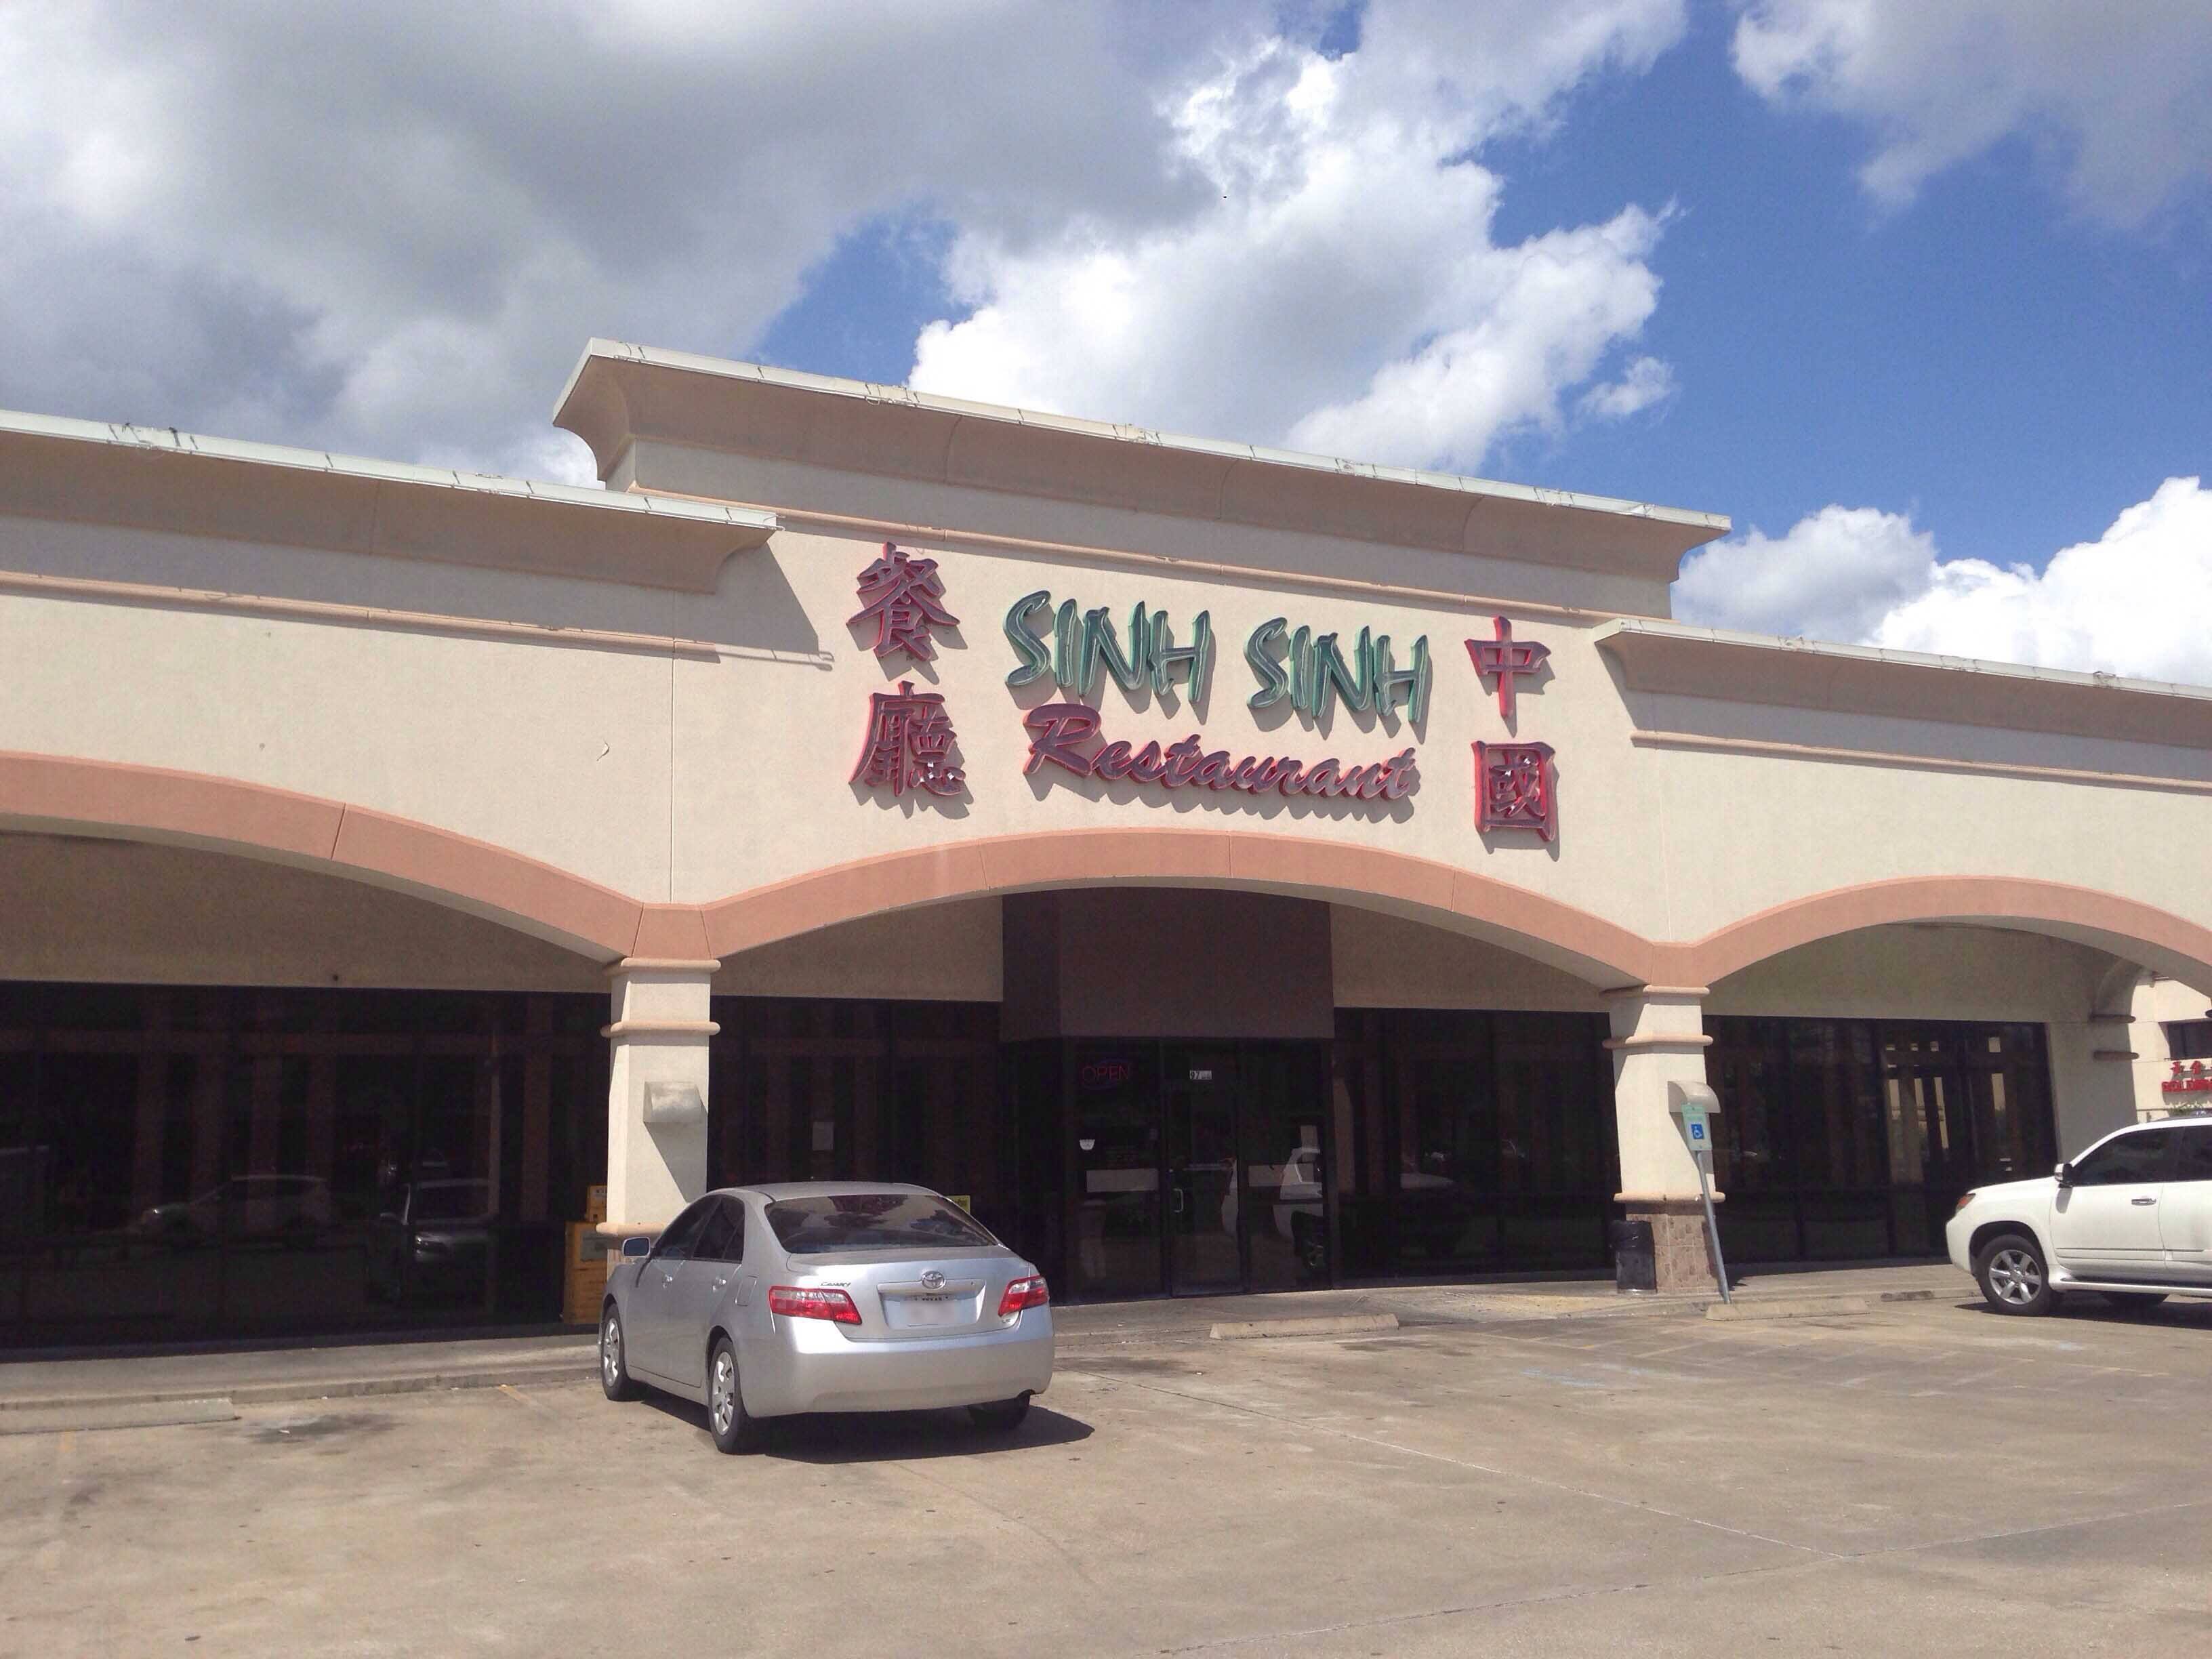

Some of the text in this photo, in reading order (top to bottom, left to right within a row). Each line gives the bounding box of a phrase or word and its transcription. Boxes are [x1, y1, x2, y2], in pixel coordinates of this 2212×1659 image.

[846, 541, 967, 797] 餐廳
[1002, 590, 1428, 722] SINH SINH
[1023, 703, 1416, 800] Restaurant
[1465, 615, 1556, 842] 中國
[1081, 1063, 1130, 1082] OPEN
